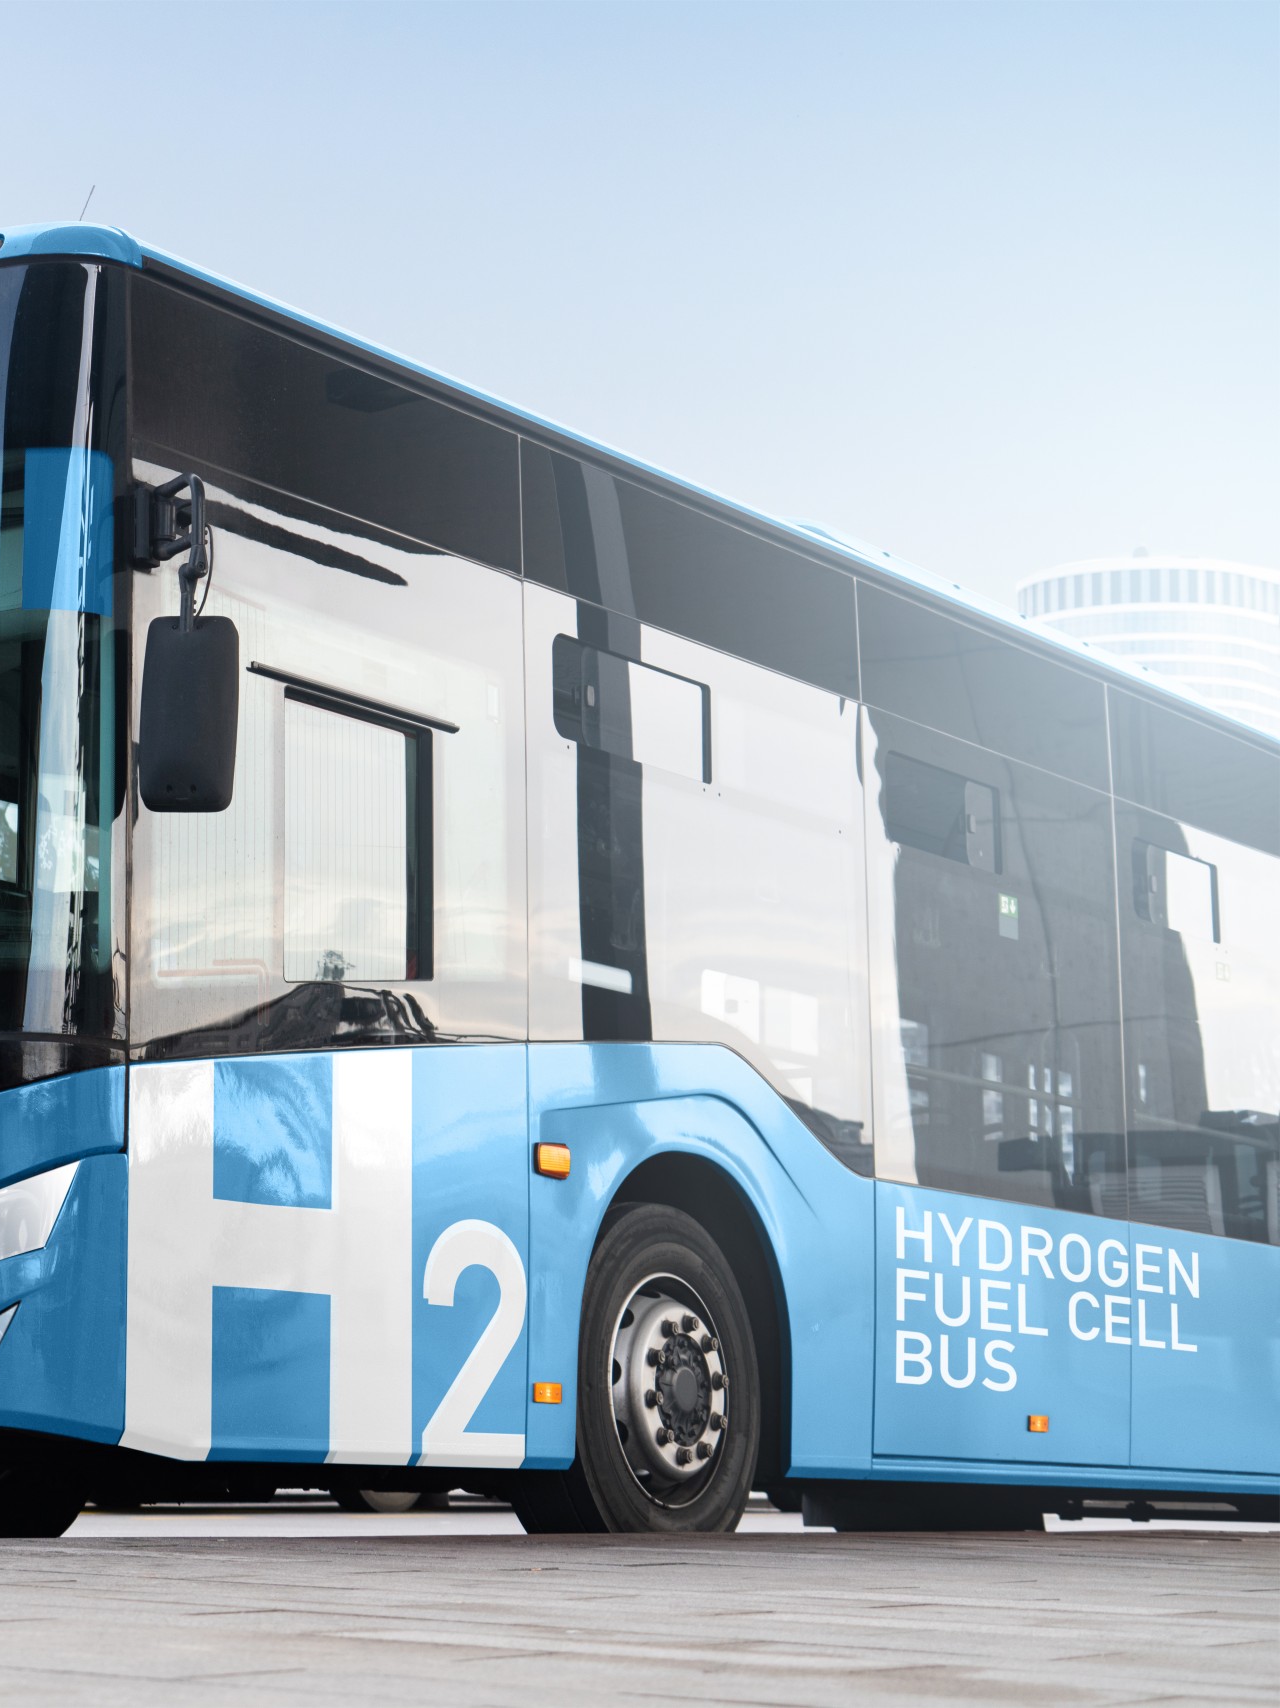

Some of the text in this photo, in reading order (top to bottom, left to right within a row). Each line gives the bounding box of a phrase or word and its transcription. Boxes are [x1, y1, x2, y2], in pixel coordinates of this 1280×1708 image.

[118, 1051, 527, 1468] H2
[895, 1205, 1200, 1299] HYDROGEN
[895, 1267, 1198, 1353] FUEL CELL
[895, 1329, 1018, 1392] BUS
